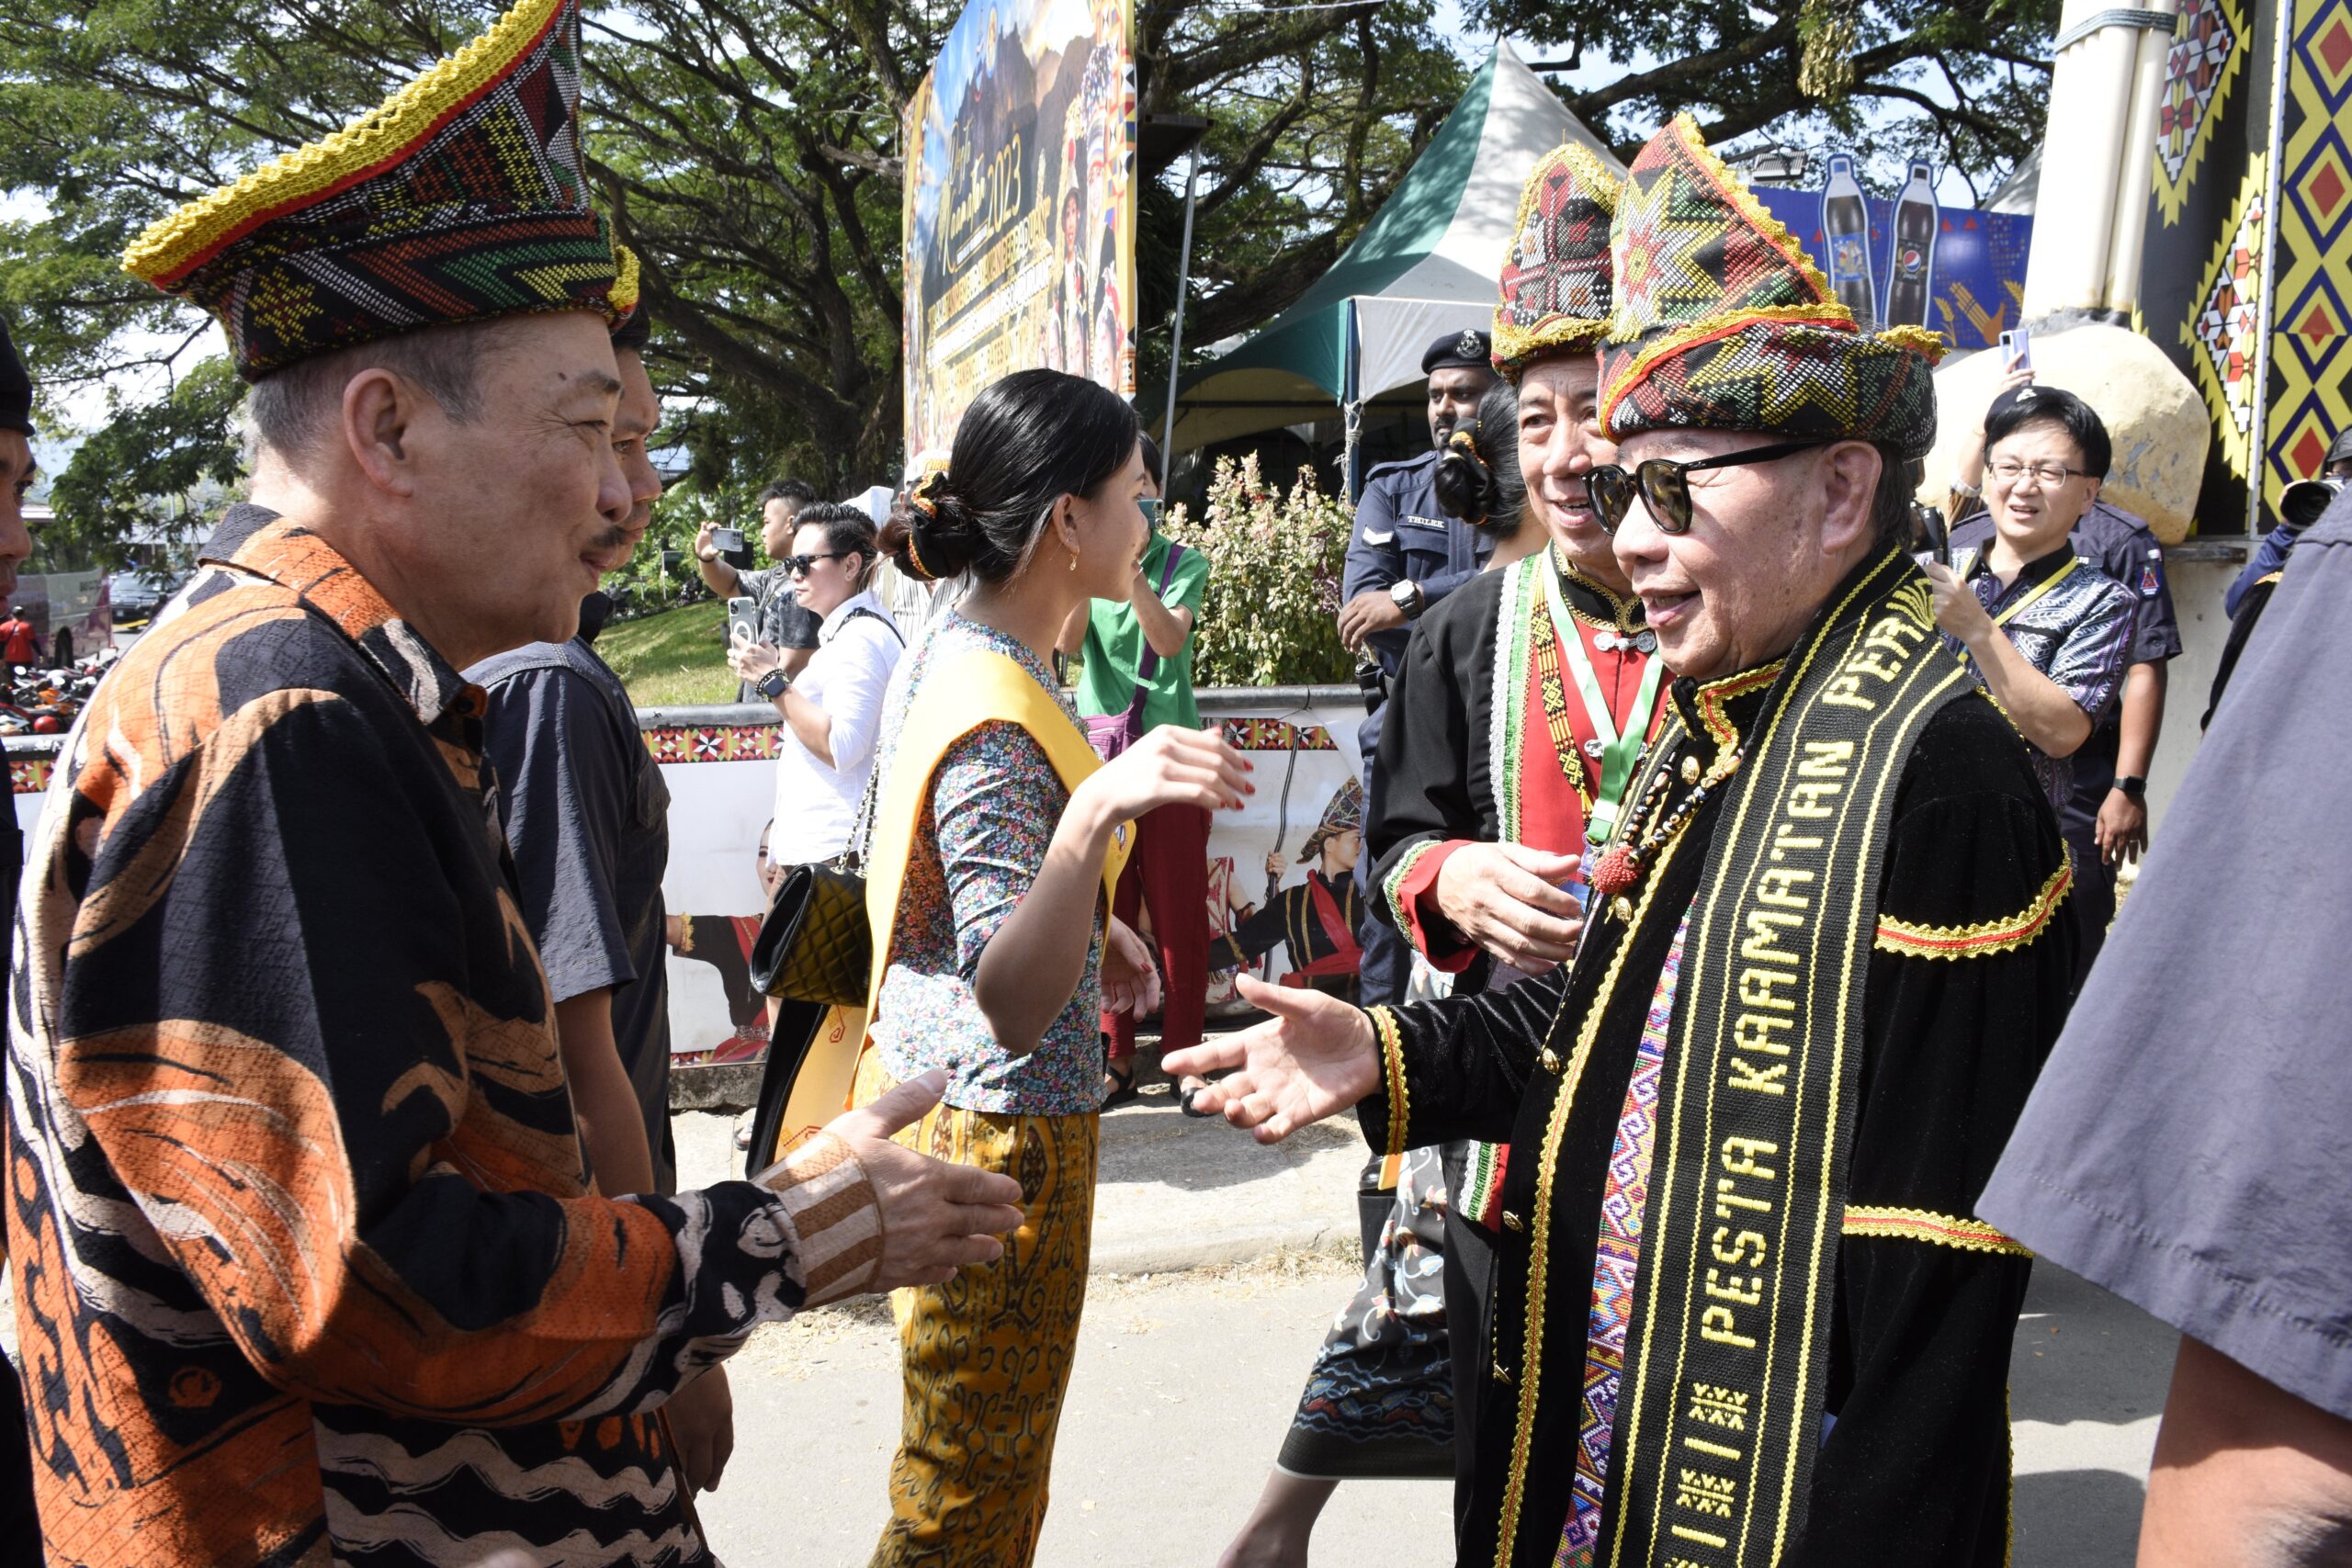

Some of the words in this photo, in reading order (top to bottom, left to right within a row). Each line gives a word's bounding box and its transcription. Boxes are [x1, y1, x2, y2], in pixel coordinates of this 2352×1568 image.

[988, 132, 1022, 238] 2023
[1728, 740, 1854, 1096] KAAMATAN
[1702, 1135, 1779, 1348] PESTA
